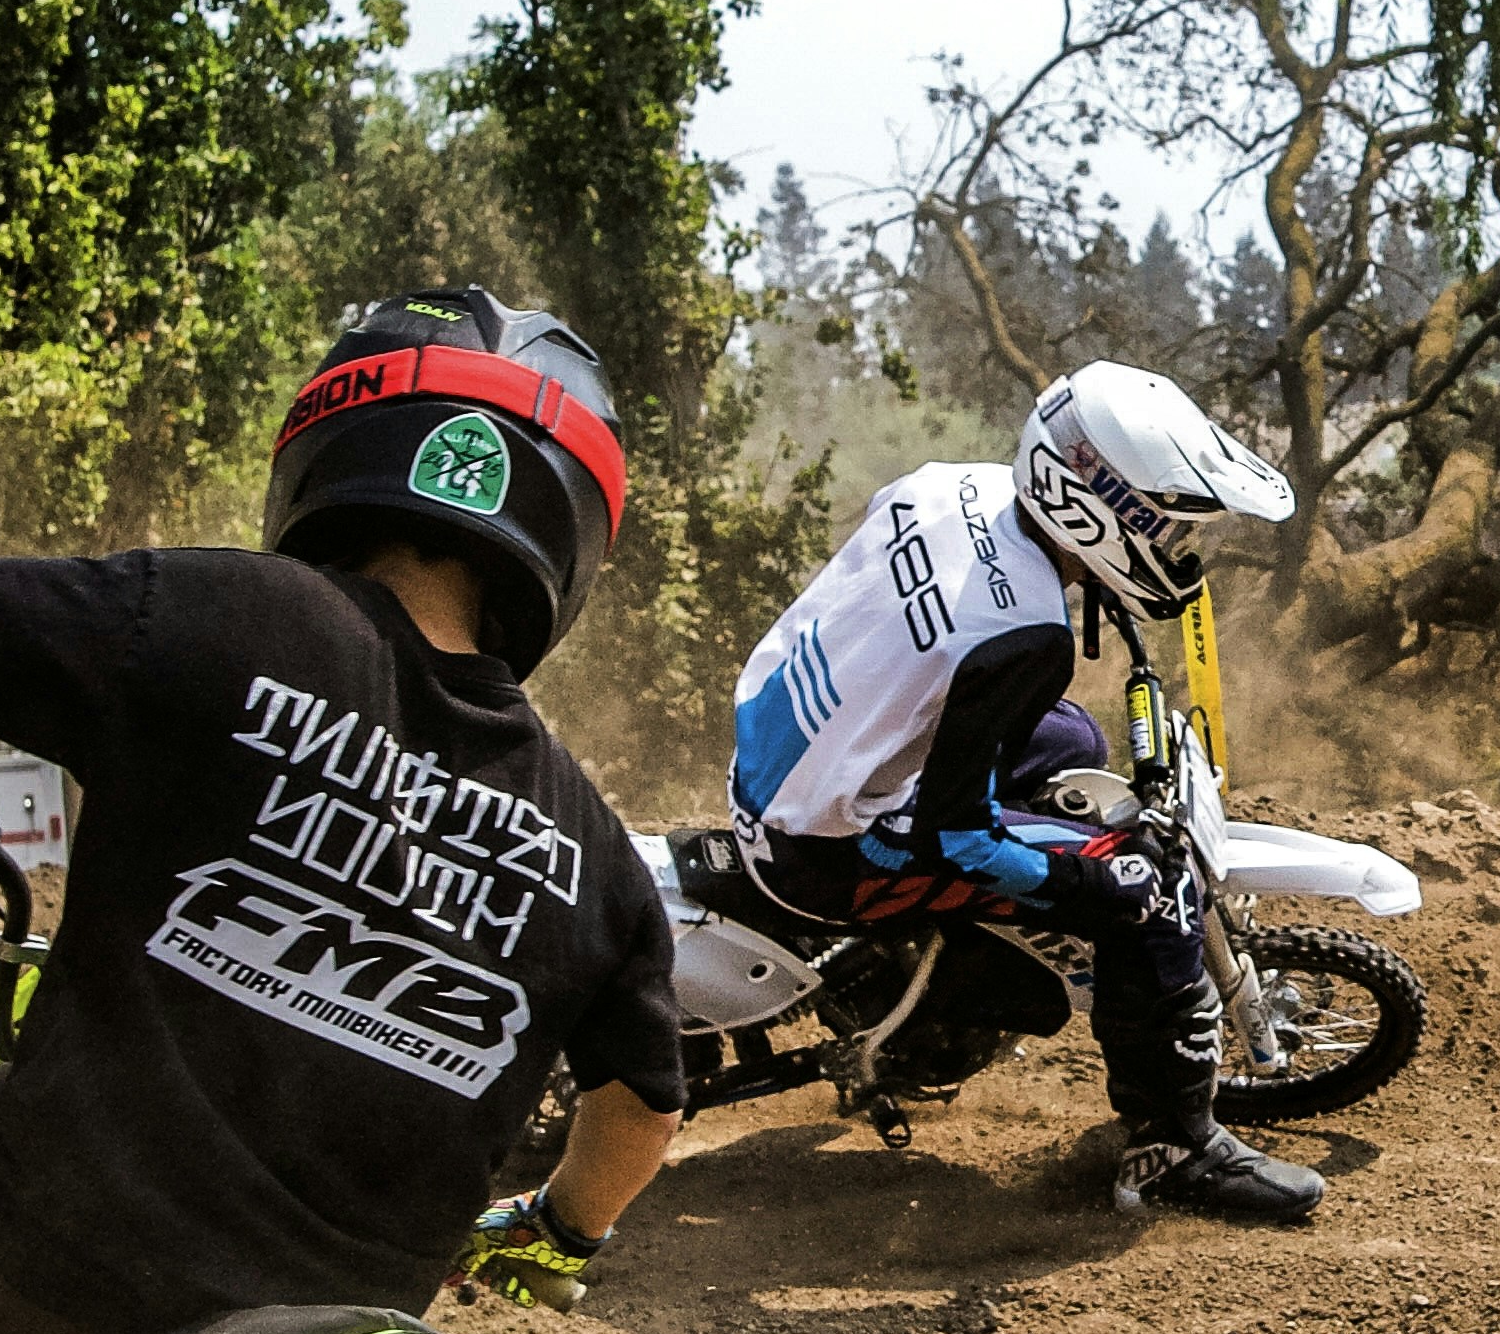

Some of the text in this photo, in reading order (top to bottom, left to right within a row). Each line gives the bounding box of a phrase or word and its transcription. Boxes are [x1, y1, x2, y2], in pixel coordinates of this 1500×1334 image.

[1090, 466, 1171, 540] viral
[886, 502, 956, 653] 485
[1191, 598, 1206, 665] ACERBI
[248, 774, 535, 958] YOUTH
[161, 926, 434, 1060] FACTORY MINIBIKES
